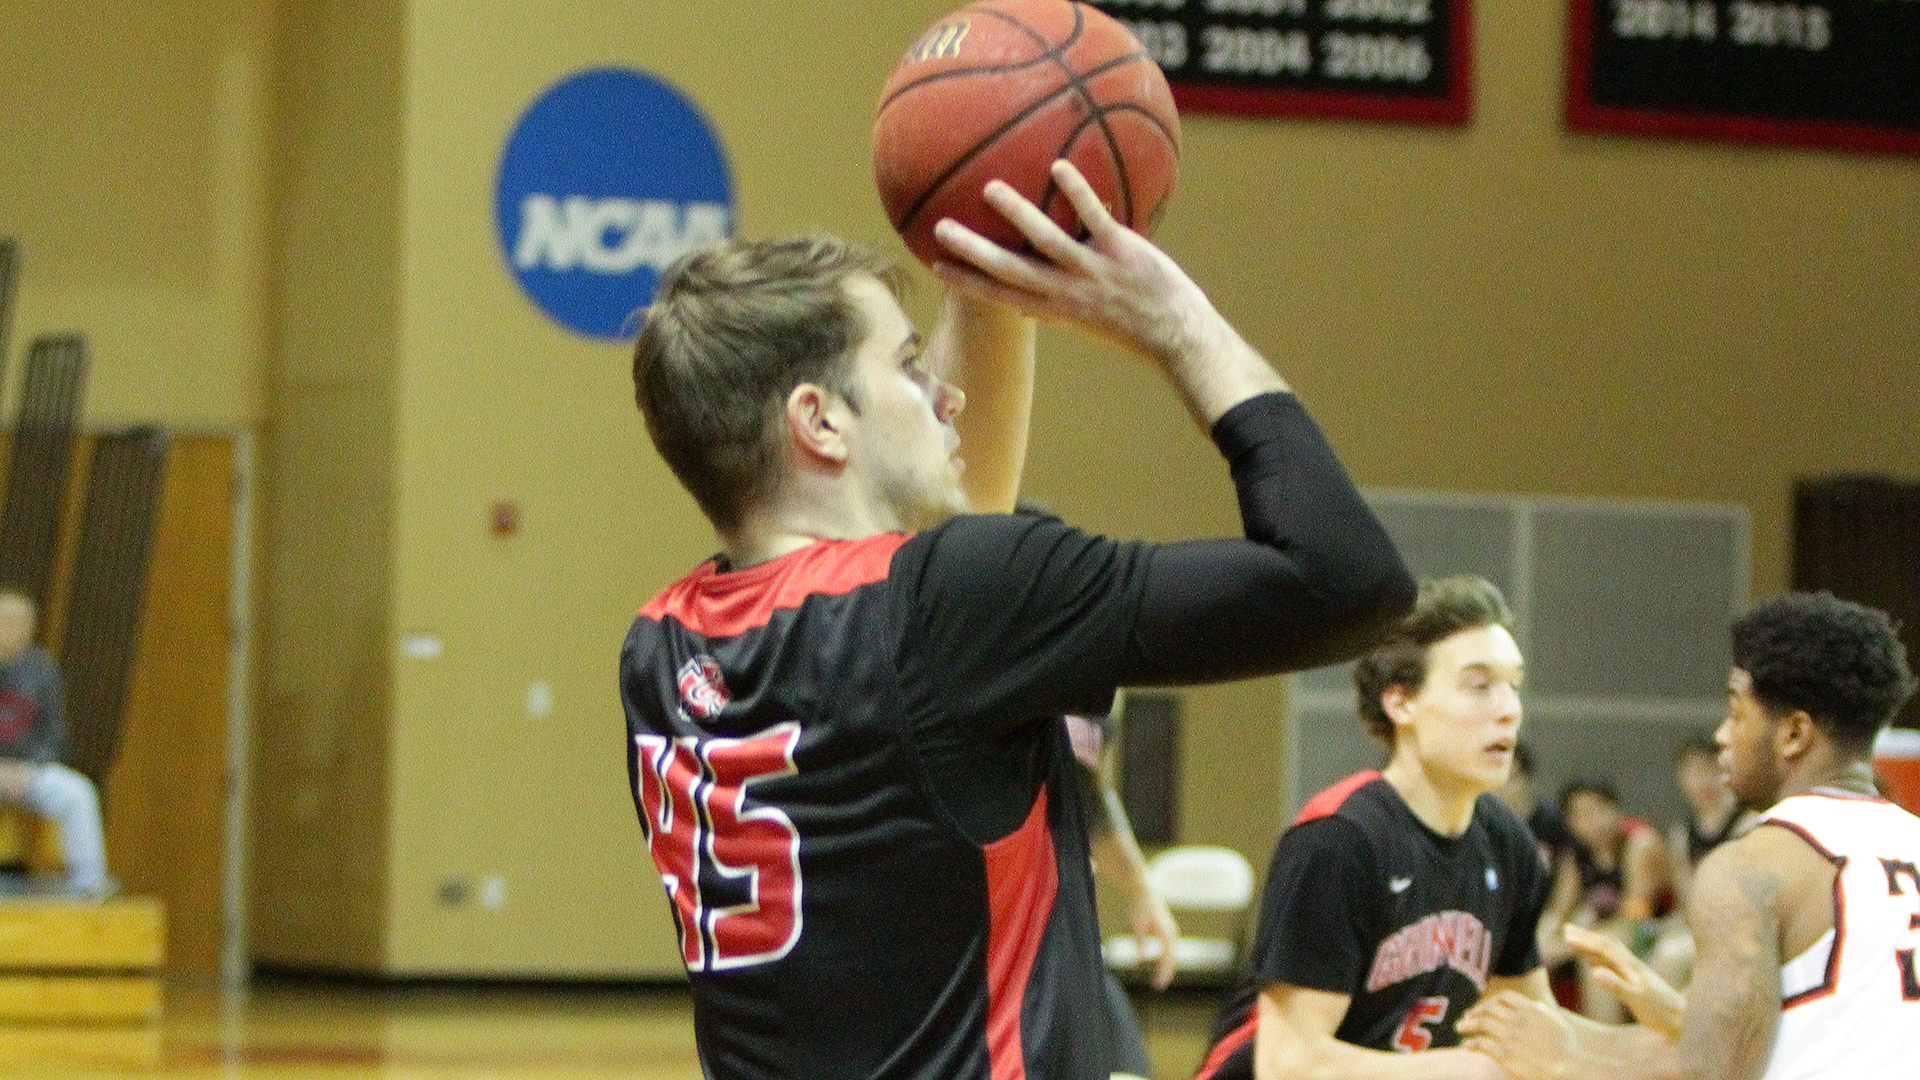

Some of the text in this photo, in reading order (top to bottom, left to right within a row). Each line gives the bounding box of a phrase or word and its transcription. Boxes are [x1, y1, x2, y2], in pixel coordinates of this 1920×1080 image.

[515, 194, 731, 273] NCAA
[634, 720, 804, 972] 45
[1392, 996, 1449, 1053] 5
